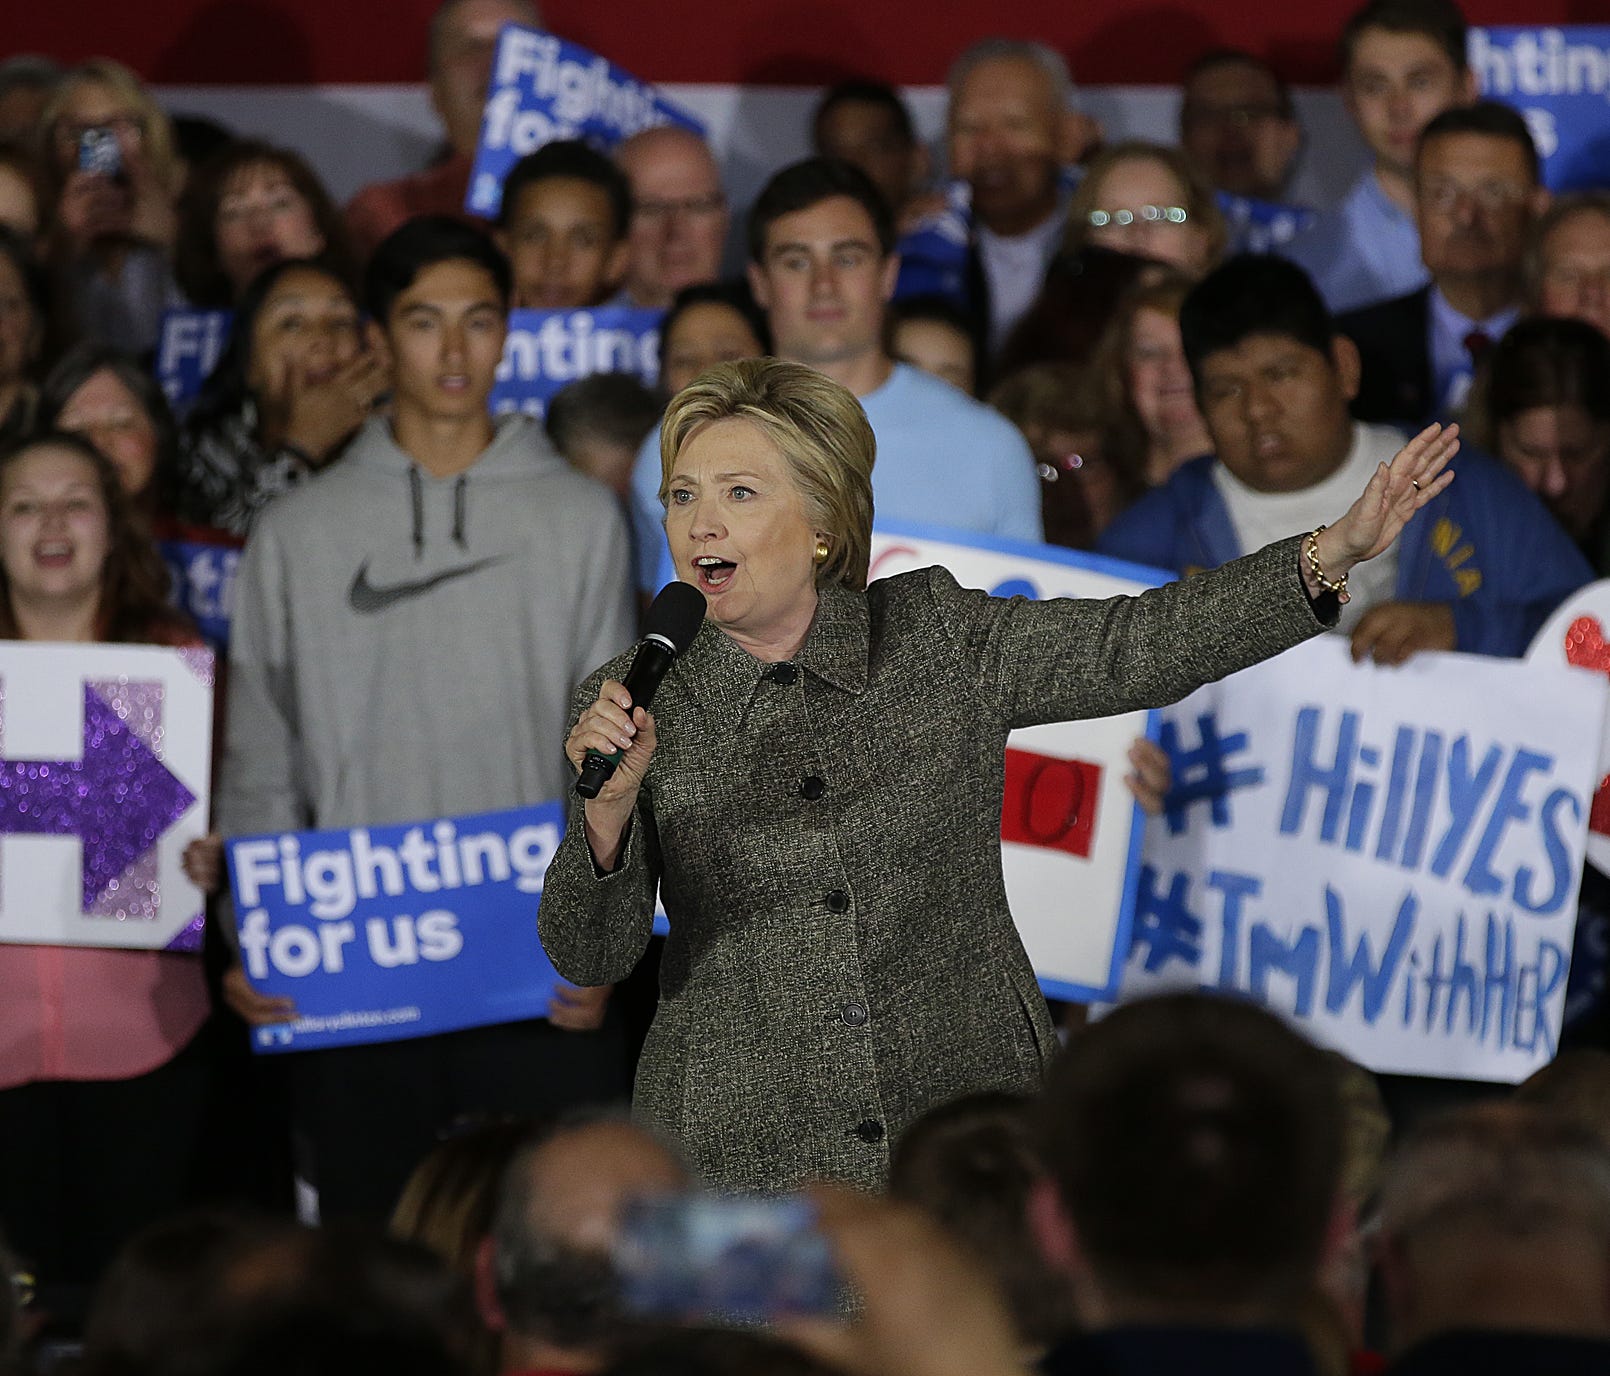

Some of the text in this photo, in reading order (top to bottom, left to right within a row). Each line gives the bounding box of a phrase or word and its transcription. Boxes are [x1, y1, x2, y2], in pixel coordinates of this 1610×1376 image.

[1465, 26, 1610, 108] htin
[232, 819, 560, 921] Fighting
[238, 907, 464, 980] for us
